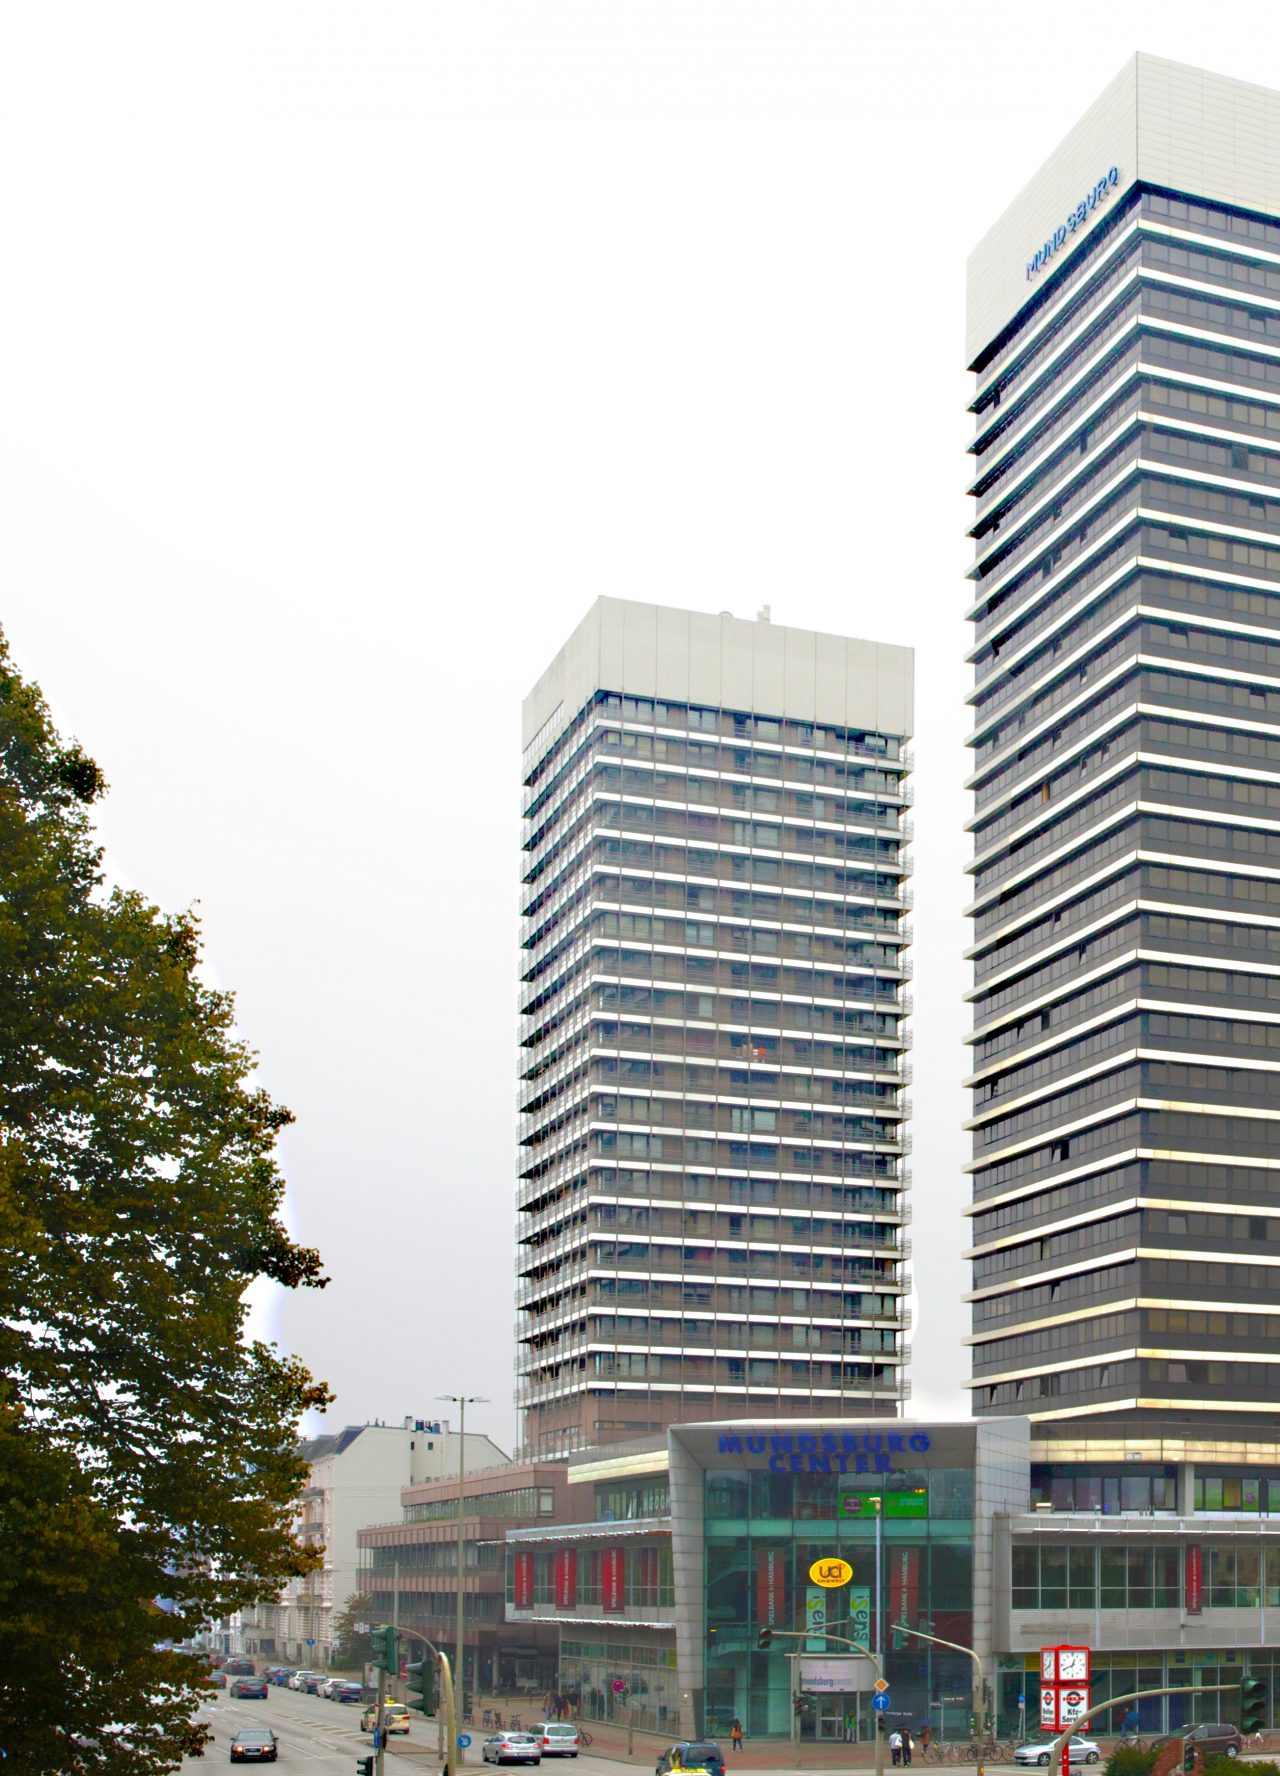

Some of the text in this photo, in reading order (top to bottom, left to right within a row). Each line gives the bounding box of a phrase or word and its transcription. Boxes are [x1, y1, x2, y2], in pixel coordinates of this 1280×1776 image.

[1026, 165, 1119, 281] MUNDSBURG
[719, 1432, 931, 1454] MUNDSBURG
[768, 1453, 894, 1473] CENTER
[819, 1563, 842, 1578] uci
